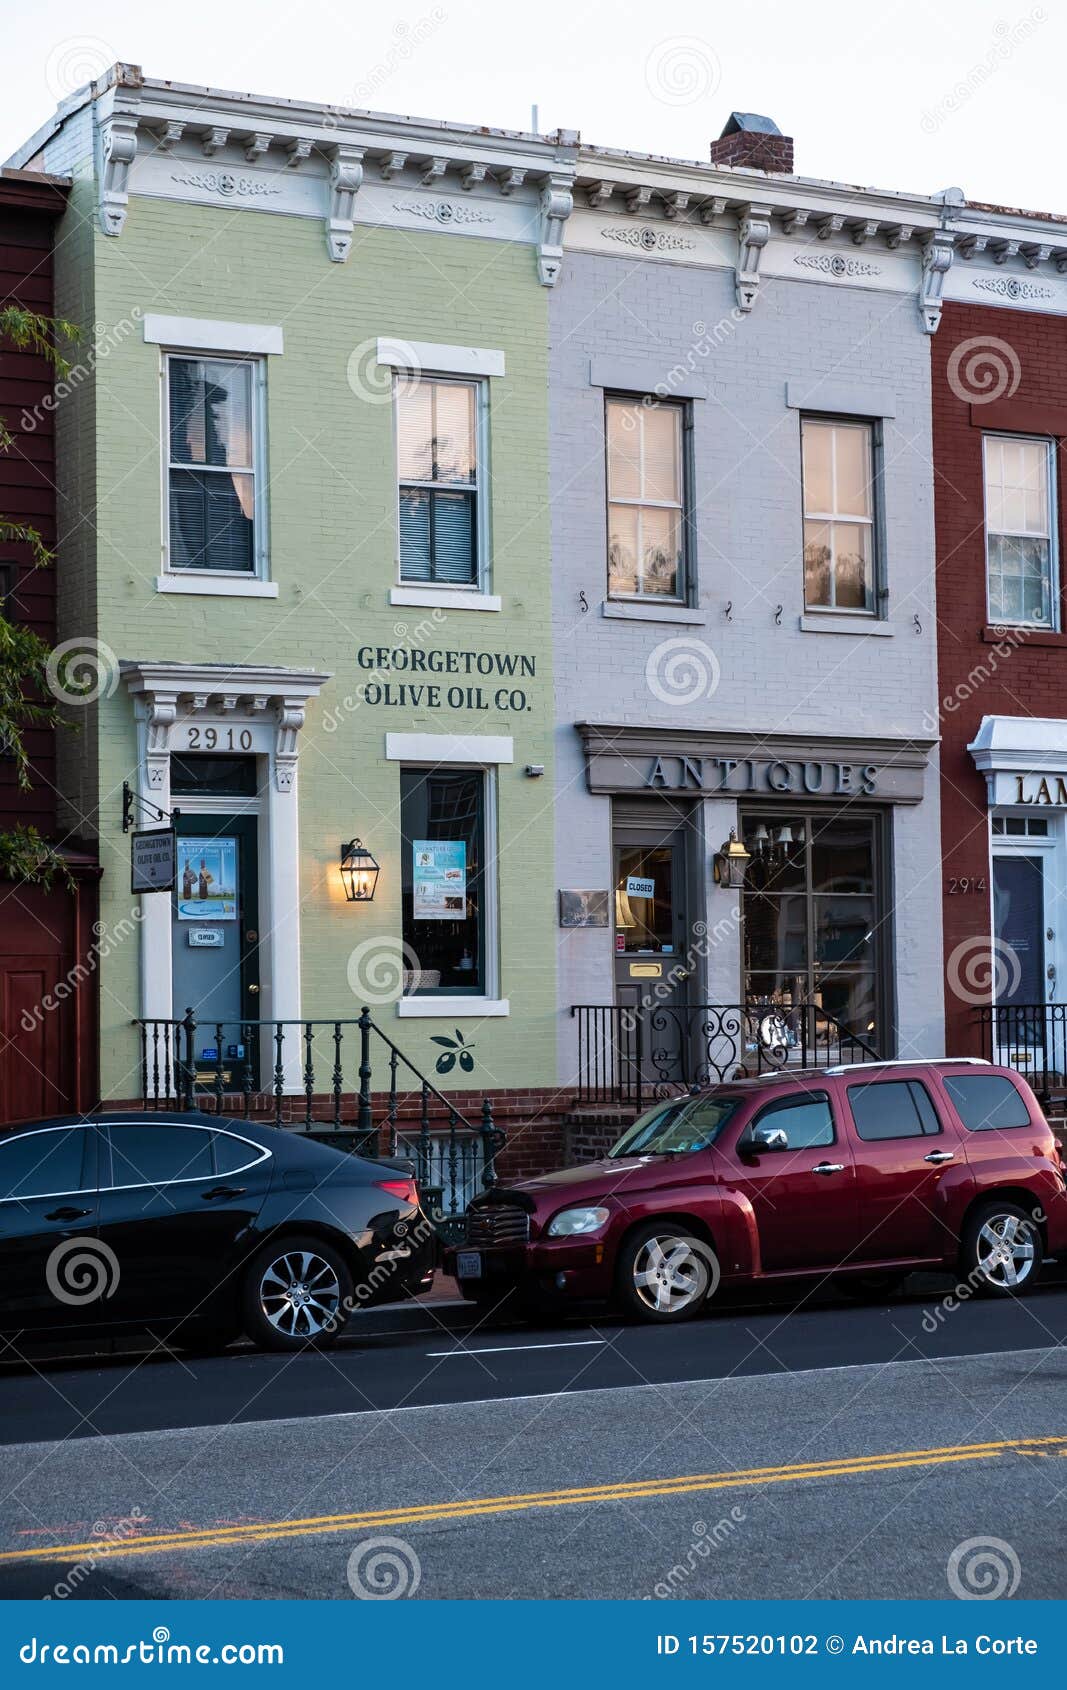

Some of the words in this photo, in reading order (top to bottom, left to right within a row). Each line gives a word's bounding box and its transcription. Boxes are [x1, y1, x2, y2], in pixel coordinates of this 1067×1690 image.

[357, 647, 537, 677] GEORGETOWN
[364, 683, 441, 707] OLIVE
[447, 687, 489, 710] OIL
[494, 688, 532, 712] CO.
[188, 727, 252, 750] 2910
[645, 756, 880, 795] ANTIQUES
[628, 882, 653, 893] CLOSED
[949, 877, 986, 894] 2914
